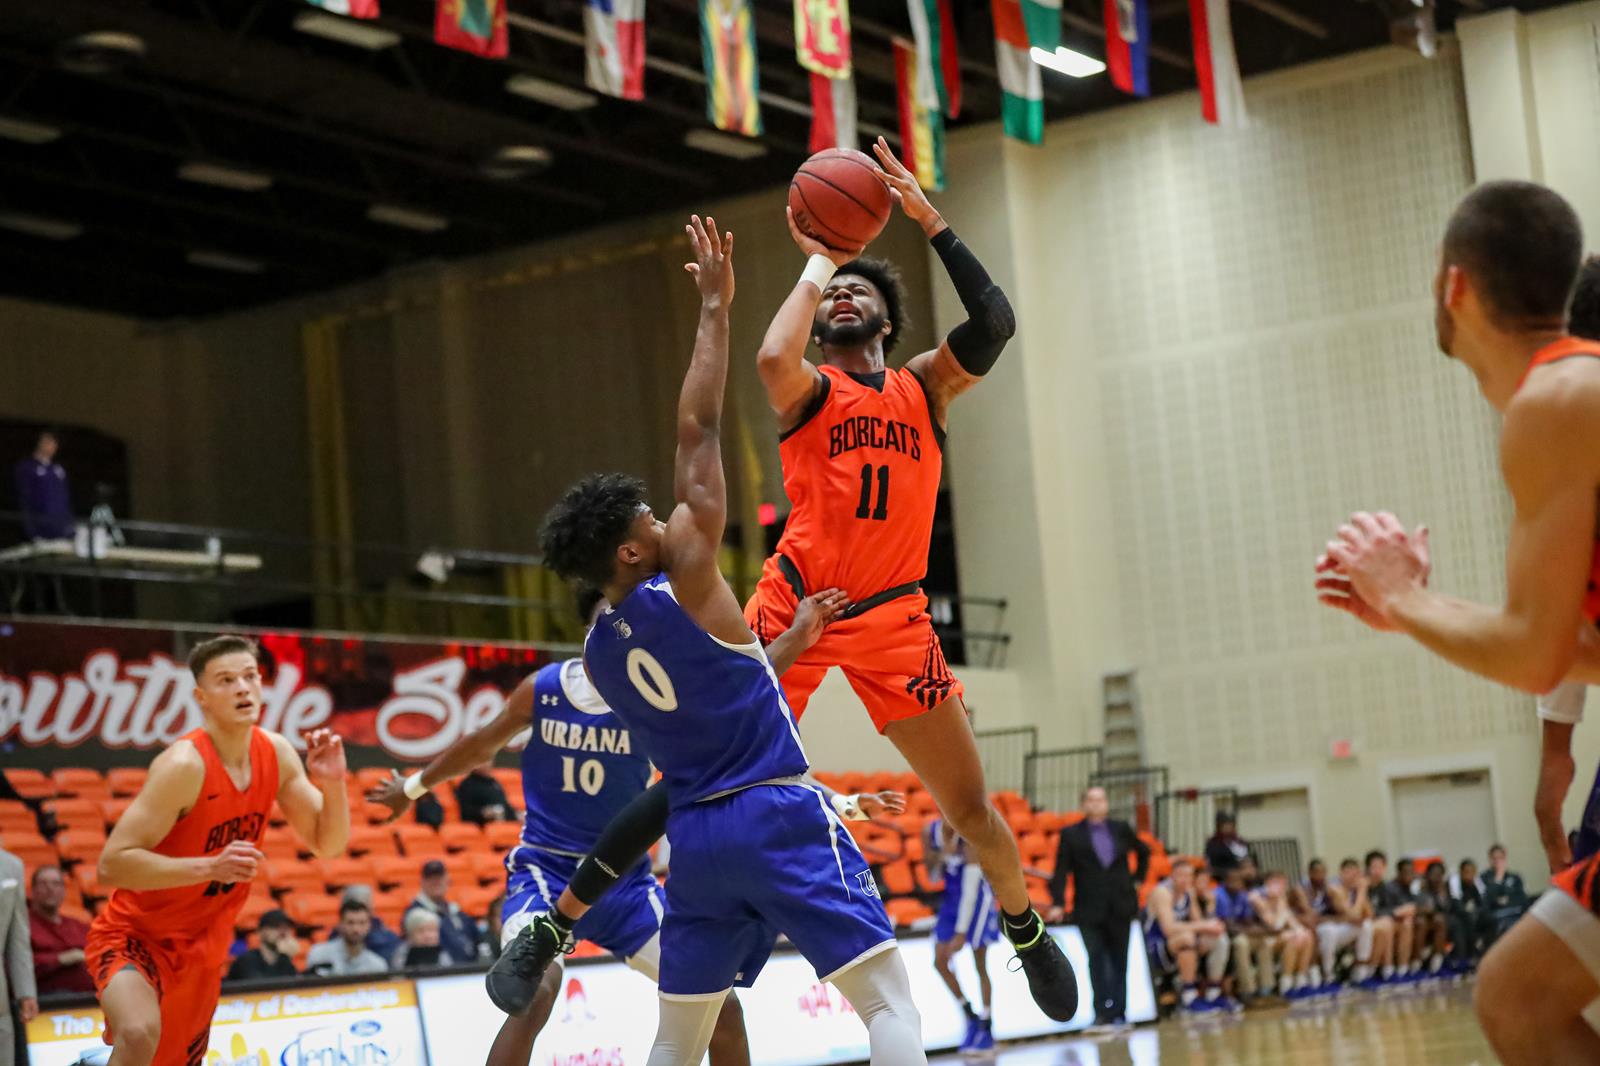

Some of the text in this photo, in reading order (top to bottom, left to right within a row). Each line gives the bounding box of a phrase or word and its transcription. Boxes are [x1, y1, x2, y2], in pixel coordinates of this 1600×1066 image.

[828, 415, 921, 462] BOBCATS
[855, 463, 889, 521] 11
[626, 647, 679, 712] 0
[541, 718, 632, 755] URBANA
[561, 755, 605, 796] 10
[256, 994, 281, 1018] of
[282, 988, 399, 1017] Dealerships
[52, 1015, 94, 1036] The
